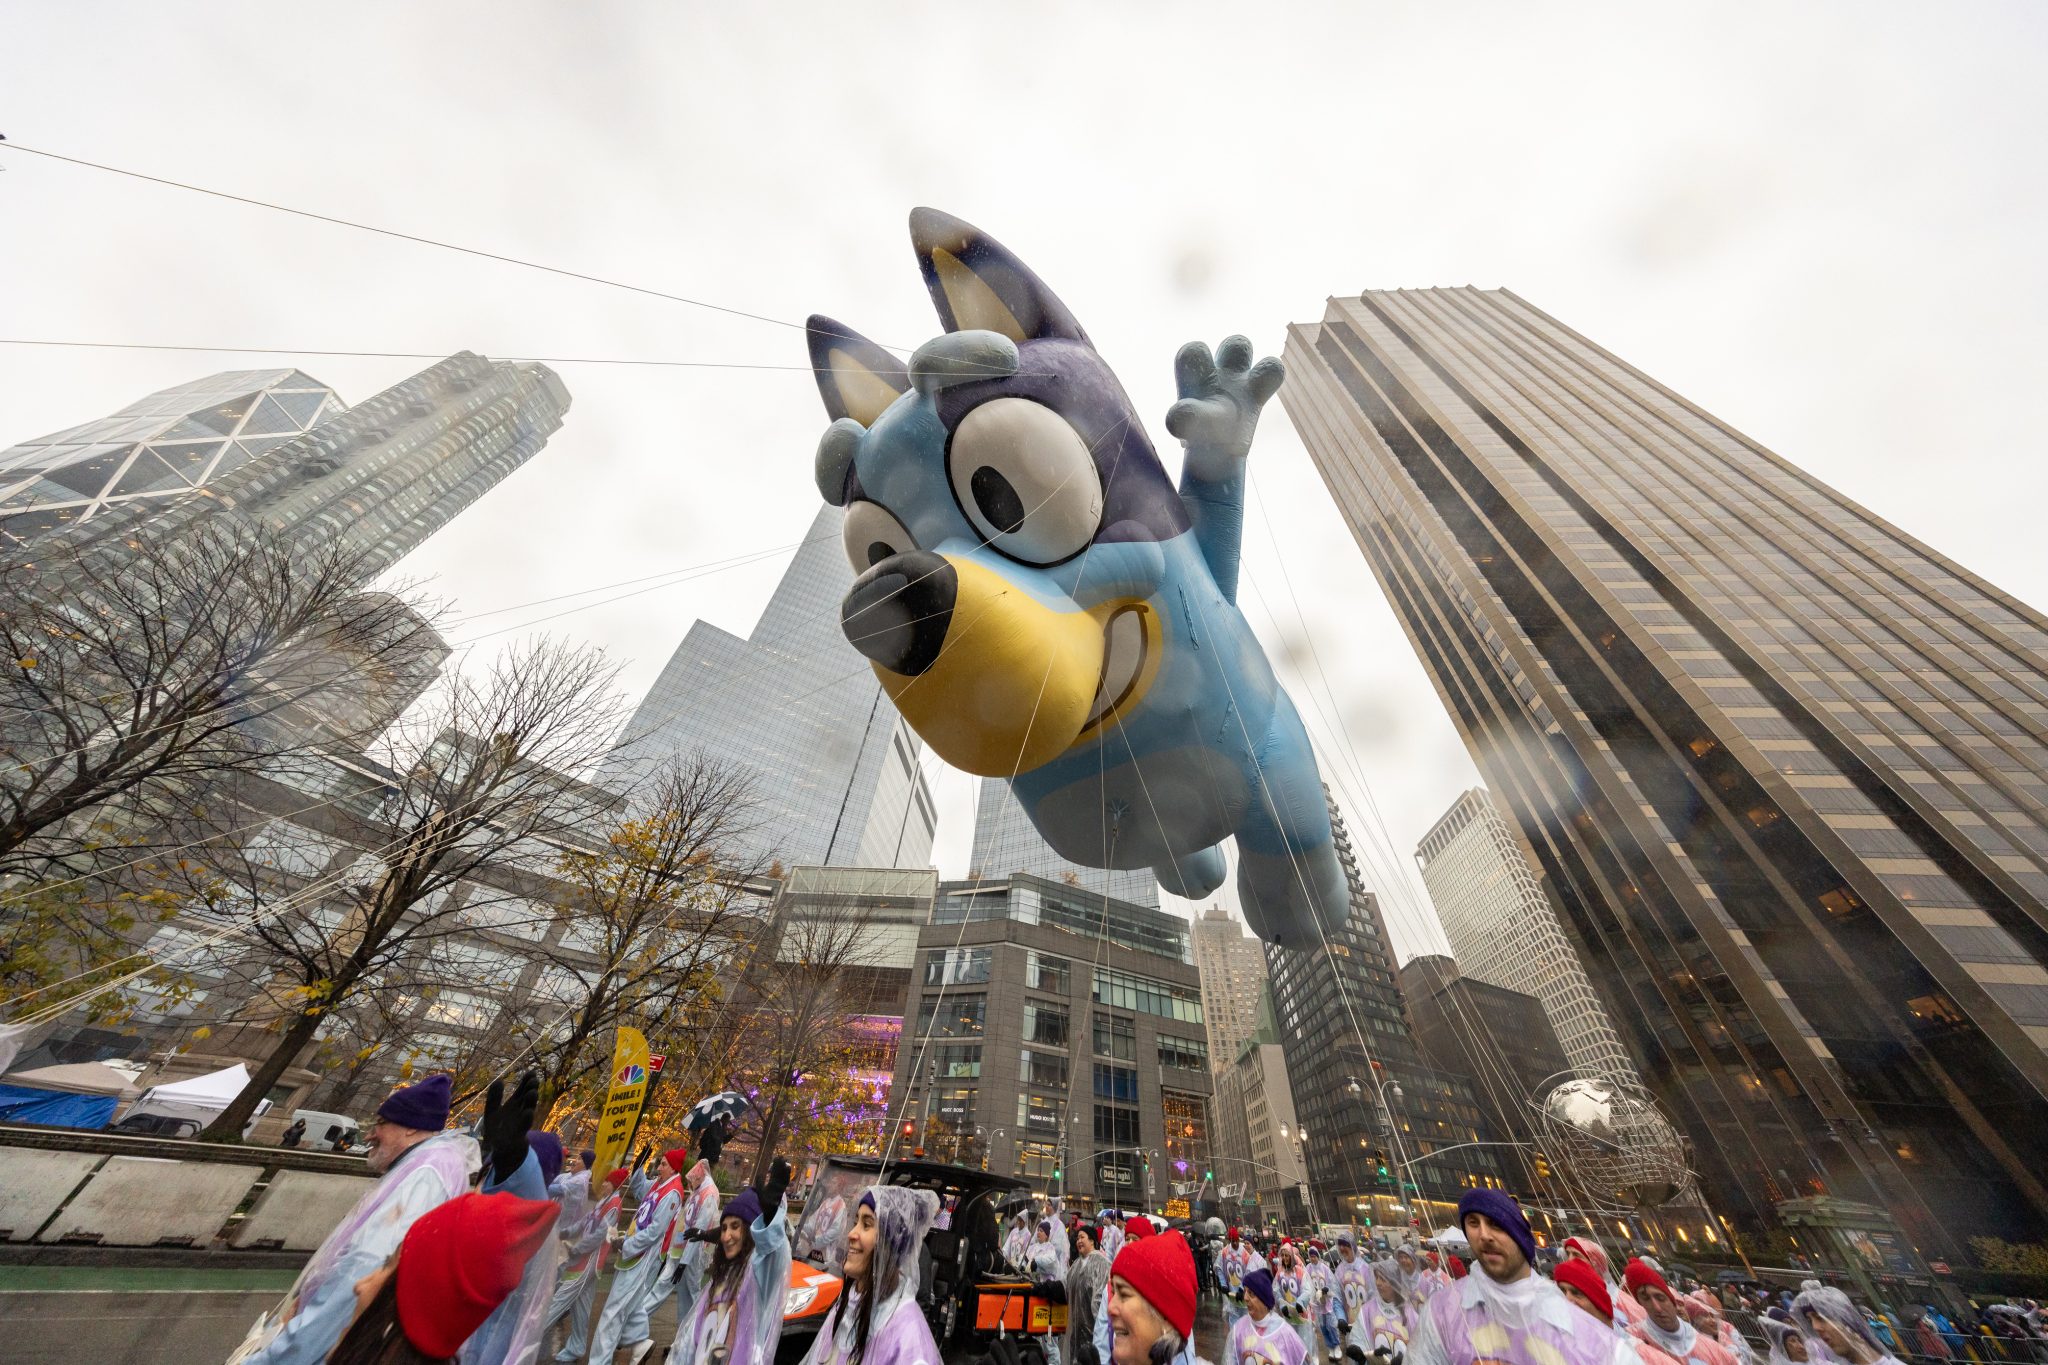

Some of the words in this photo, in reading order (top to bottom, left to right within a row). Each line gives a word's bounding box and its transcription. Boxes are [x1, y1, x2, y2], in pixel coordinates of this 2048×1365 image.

[606, 1102, 639, 1116] YOU'RE
[613, 1118, 627, 1128] ON
[607, 1132, 625, 1144] NBC
